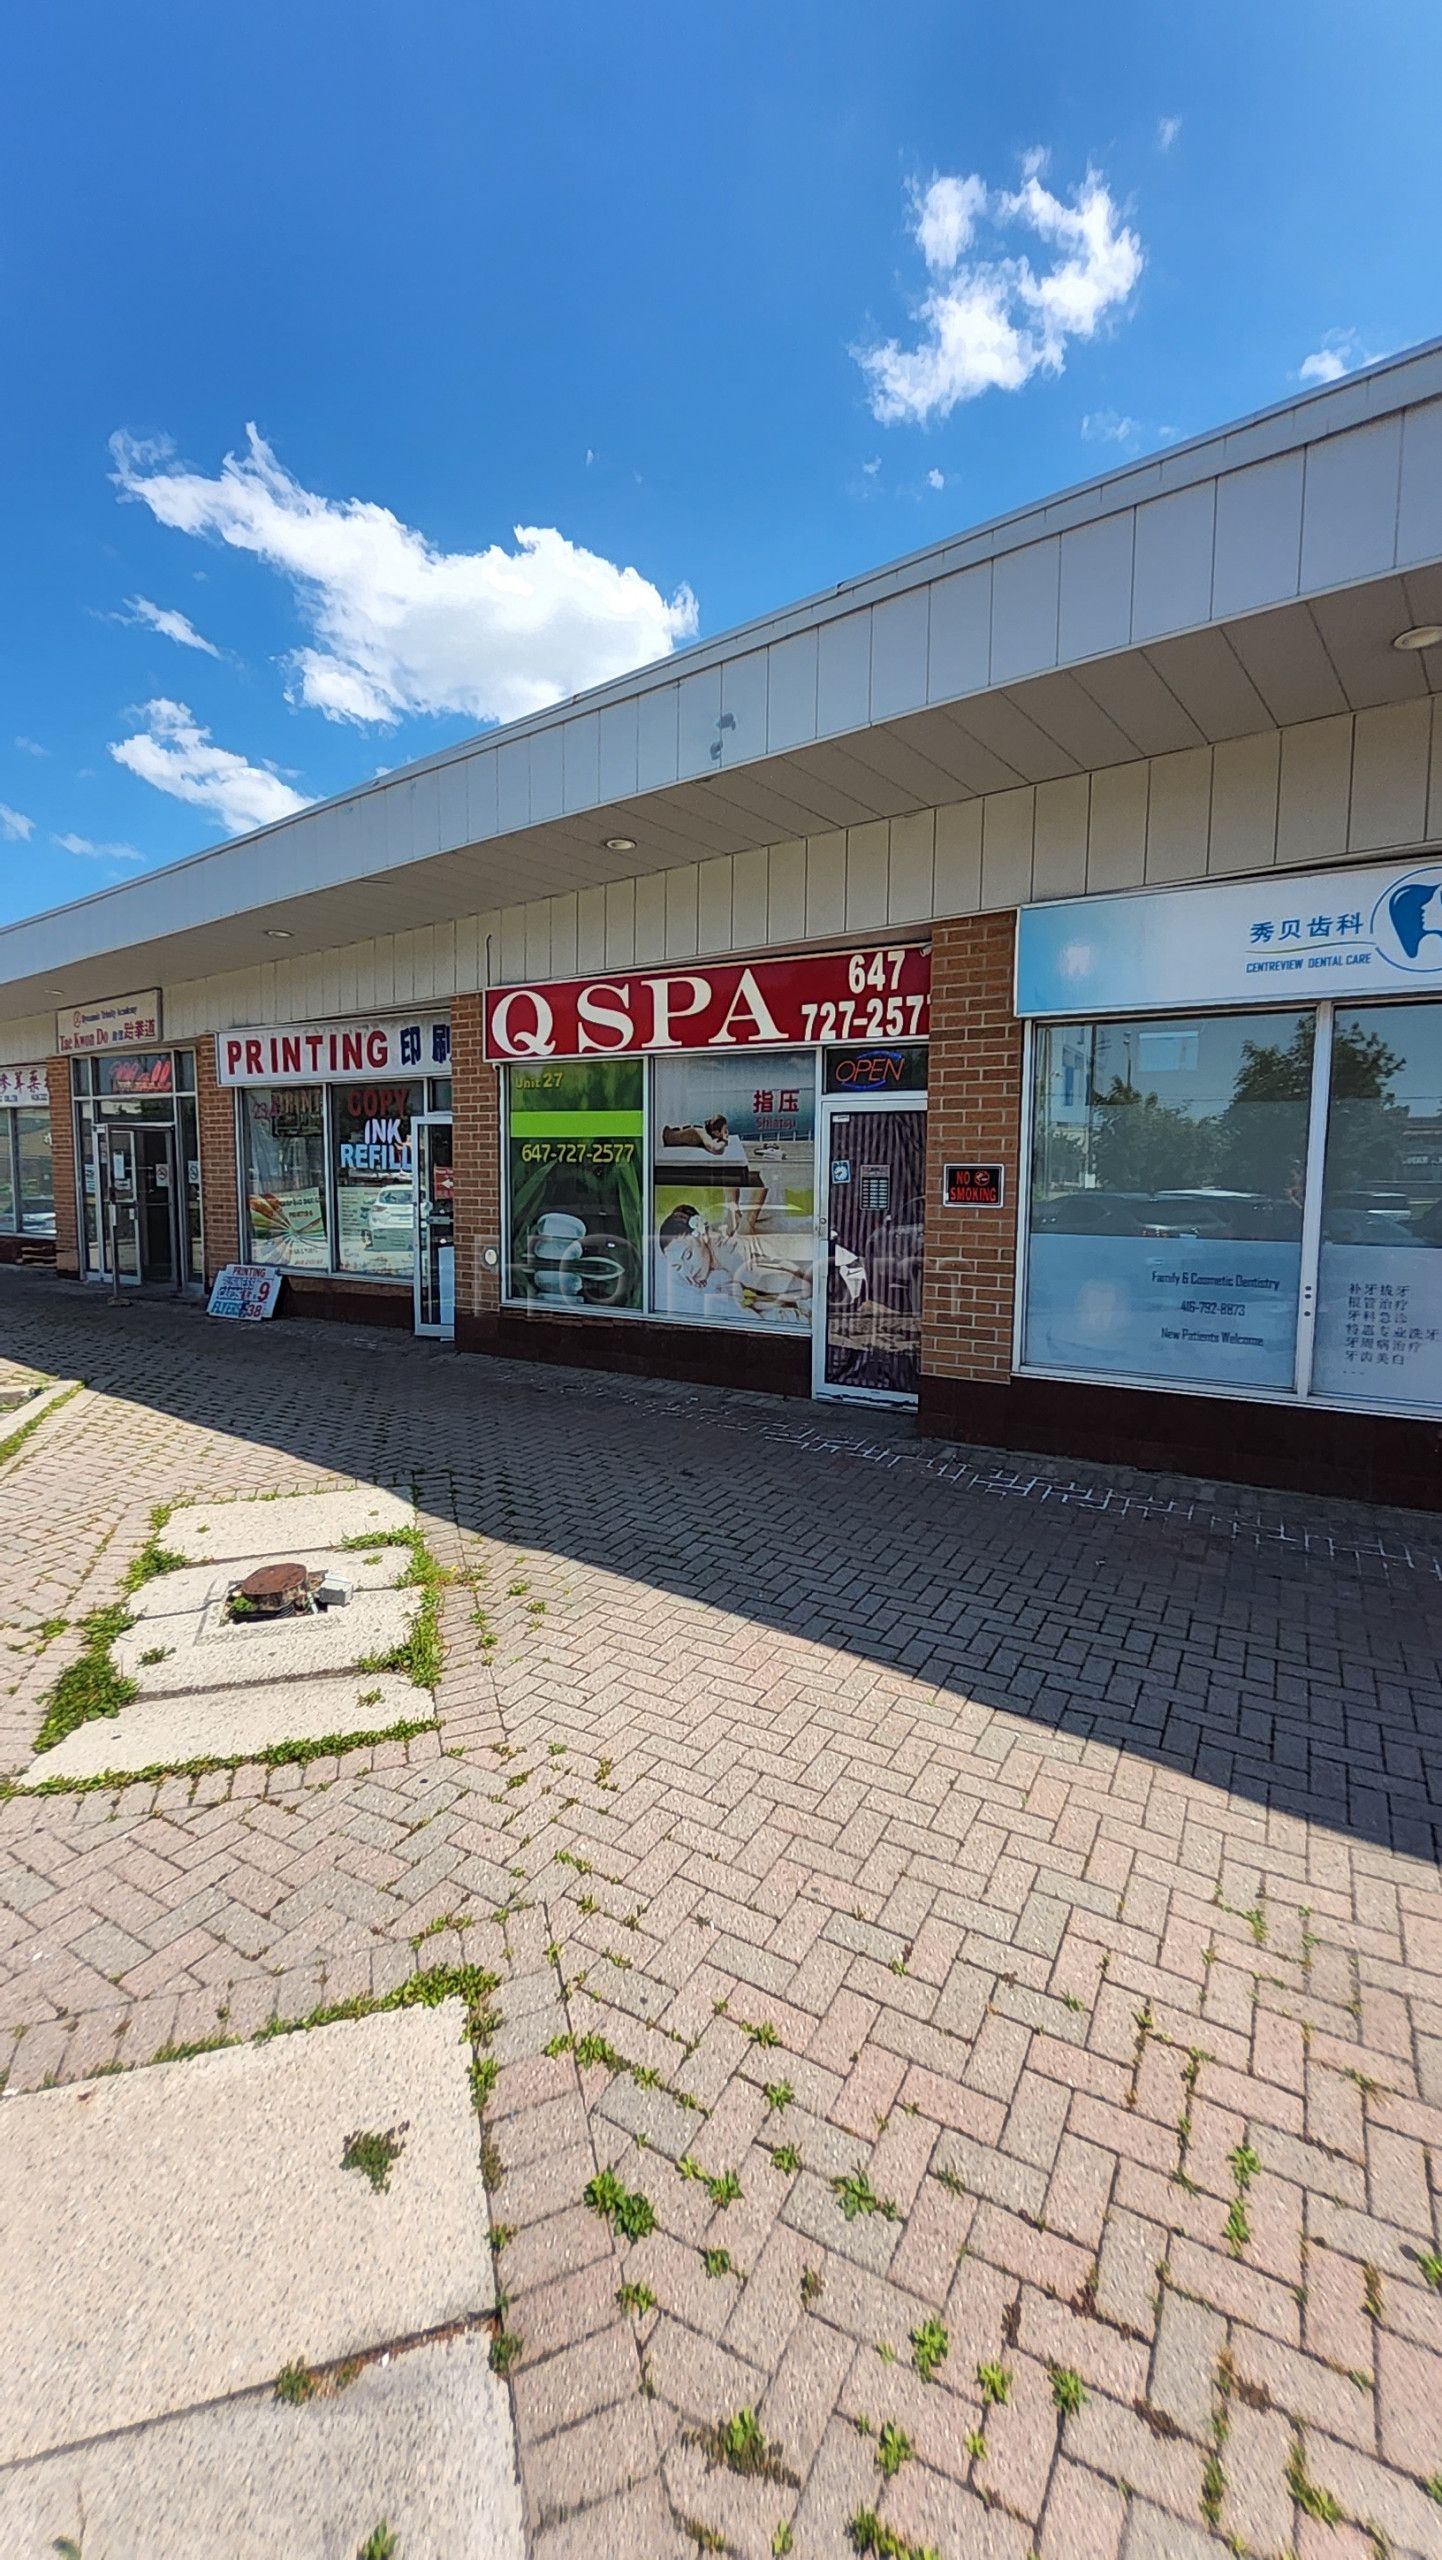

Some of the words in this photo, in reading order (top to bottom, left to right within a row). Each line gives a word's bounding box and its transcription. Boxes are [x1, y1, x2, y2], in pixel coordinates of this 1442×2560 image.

[1250, 912, 1363, 943] 秀贝齿科
[848, 950, 906, 994] 647
[1246, 958, 1303, 973] CENTREVIEW
[1308, 955, 1344, 968] DENTAL
[1345, 953, 1372, 966] CARE
[491, 990, 556, 1056] Q
[576, 968, 789, 1053] SPA
[801, 994, 931, 1041] 727-257
[59, 1035, 72, 1051] Tae
[74, 1032, 95, 1049] Kwon
[96, 1028, 109, 1045] Do
[227, 1030, 388, 1075] PRINTING
[516, 1078, 540, 1089] Unit
[542, 1072, 563, 1088] 27
[835, 1058, 905, 1083] OPEN
[347, 1088, 410, 1117] COPY
[753, 1089, 800, 1113] 指压
[364, 1118, 403, 1145] INK
[340, 1143, 413, 1170] REFILL
[521, 1144, 634, 1163] 647-727-2577
[956, 1170, 970, 1185] NO
[950, 1186, 997, 1202] SMOKING
[233, 1266, 266, 1278] PRINTING
[1152, 1271, 1180, 1286] Family
[1182, 1272, 1189, 1284] &
[1191, 1272, 1234, 1287] Cosmetic
[1236, 1275, 1281, 1291] Dentistry
[1180, 1300, 1246, 1317] 416-792-8873
[1161, 1327, 1181, 1340] New
[1182, 1328, 1219, 1343] Patients
[1221, 1331, 1264, 1347] Welcome
